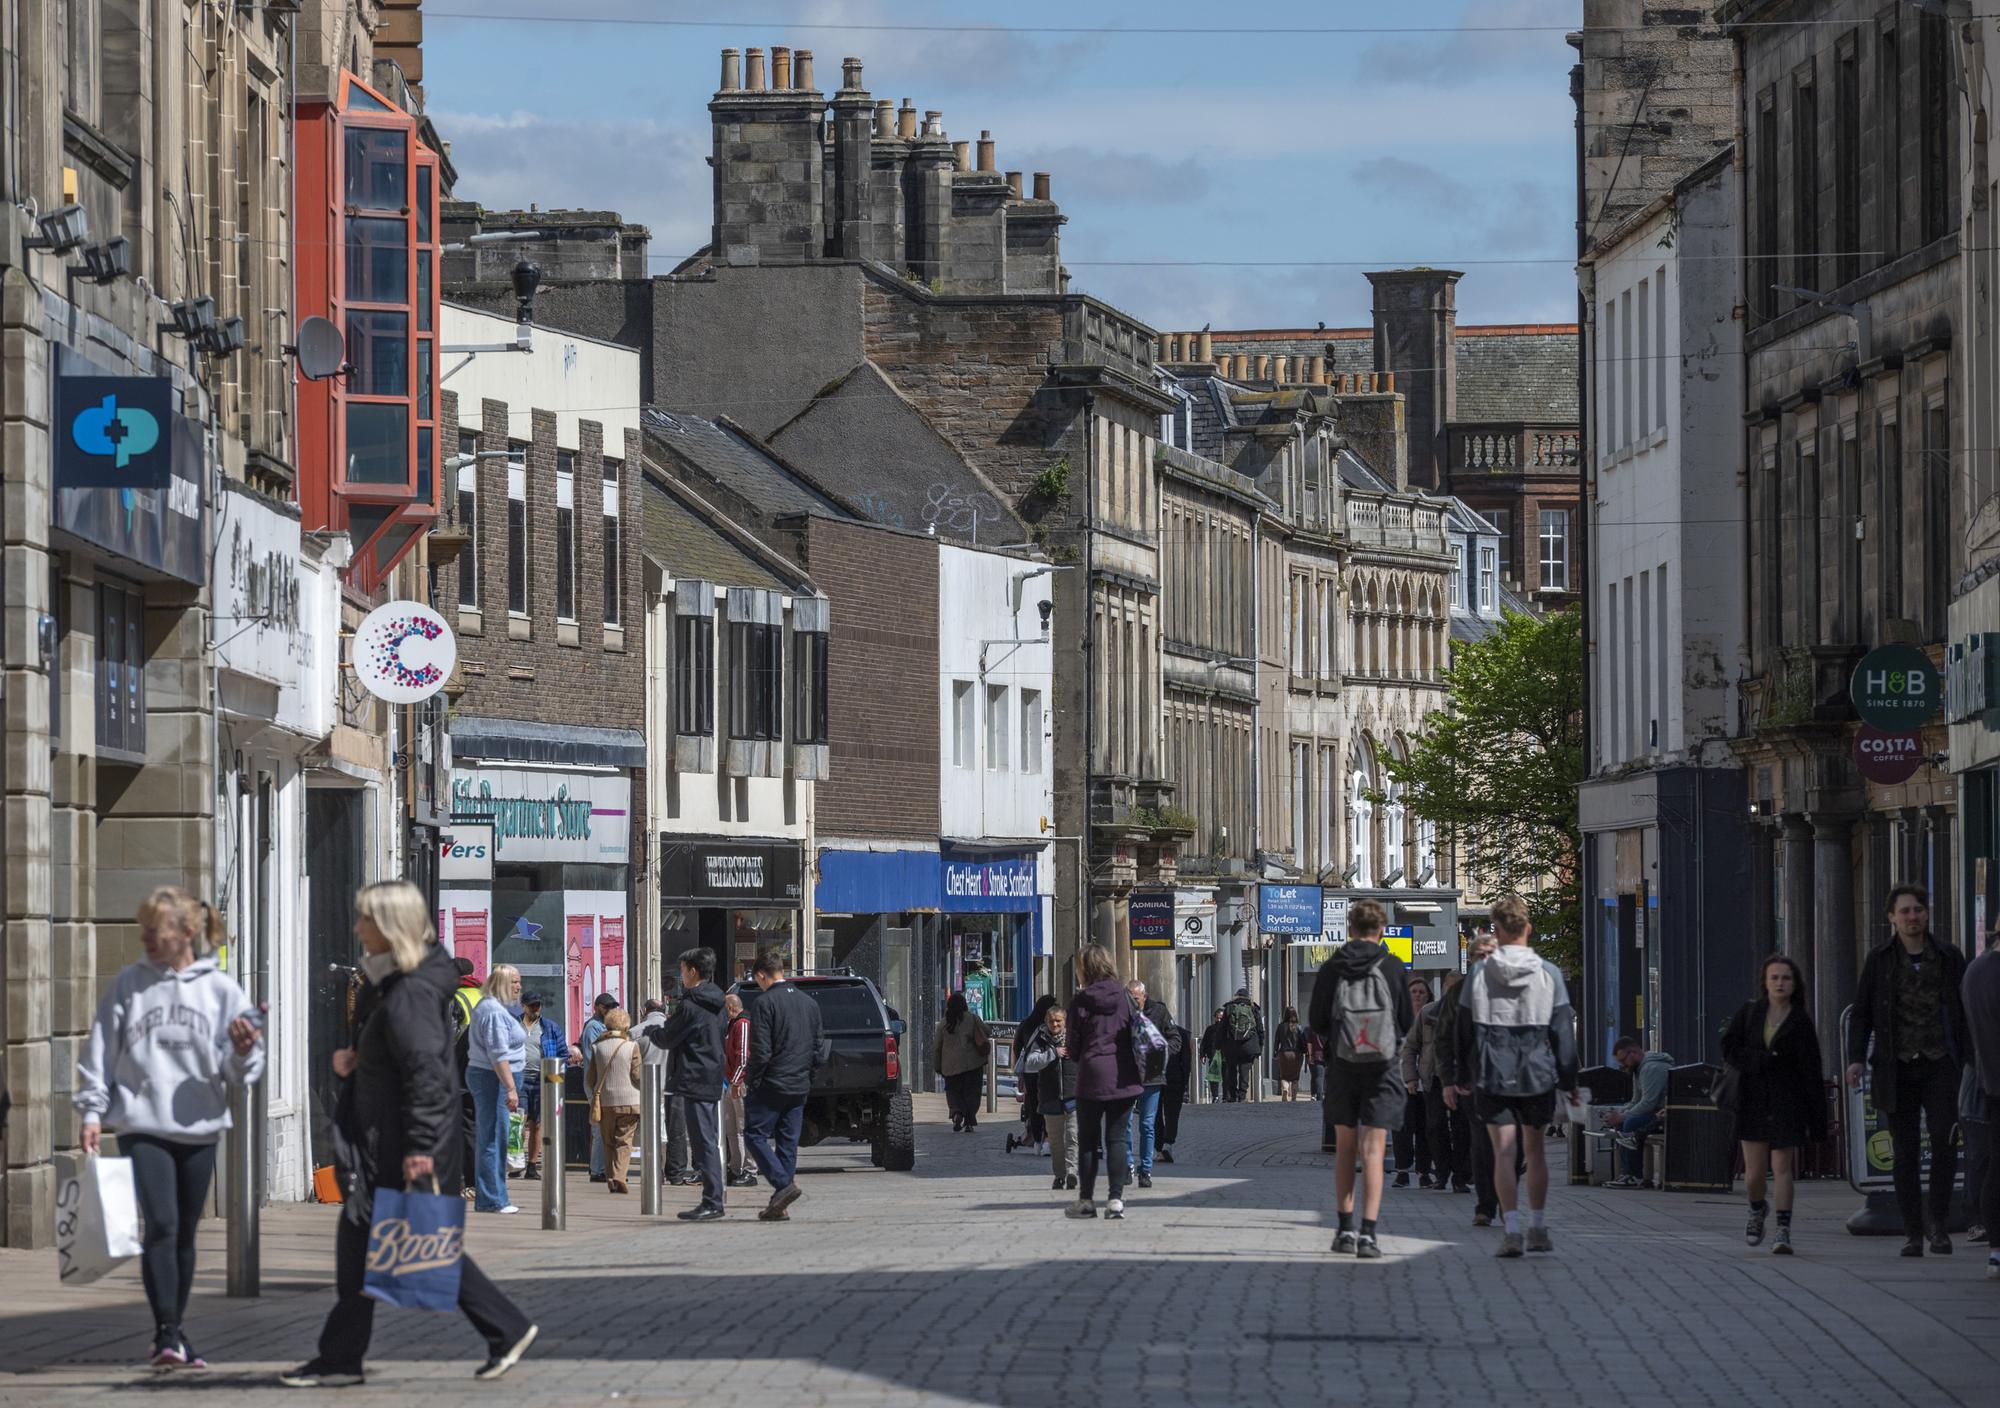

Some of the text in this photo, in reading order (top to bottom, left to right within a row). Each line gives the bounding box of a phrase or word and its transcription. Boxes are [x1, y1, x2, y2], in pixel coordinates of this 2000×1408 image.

[1866, 670, 1926, 695] H&B
[1902, 700, 1926, 708] 1870
[1860, 738, 1917, 753] COSTA
[1873, 754, 1905, 762] COFFEE
[479, 779, 557, 852] Department
[557, 783, 592, 840] Store
[706, 856, 763, 888] WATERSTONES
[946, 865, 1033, 896] Chest Heart & Stroke Scotland
[1132, 918, 1169, 926] CASINO
[1267, 915, 1298, 925] Ryden
[1383, 927, 1402, 936] LET
[1420, 941, 1436, 955] COFFEE
[1436, 941, 1447, 955] BOX
[56, 1180, 80, 1280] M&S
[367, 1217, 463, 1277] Boots
